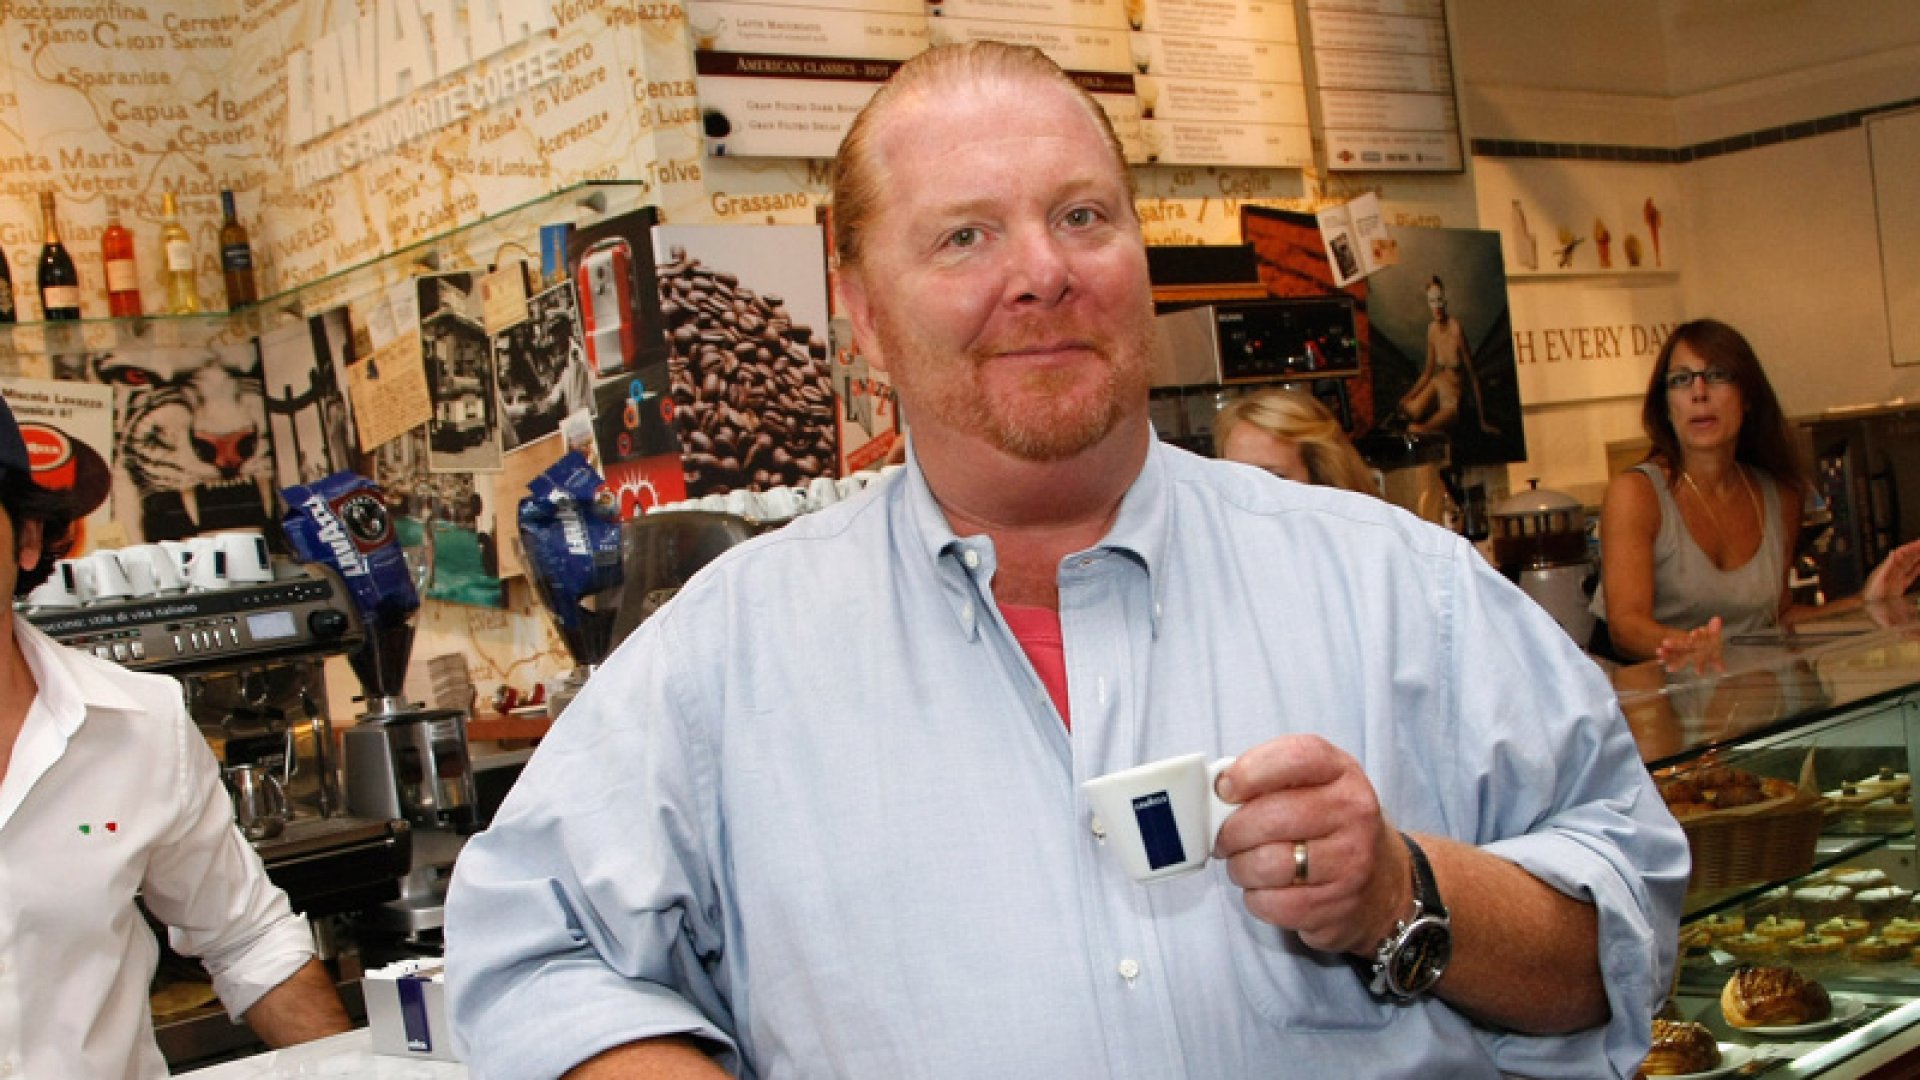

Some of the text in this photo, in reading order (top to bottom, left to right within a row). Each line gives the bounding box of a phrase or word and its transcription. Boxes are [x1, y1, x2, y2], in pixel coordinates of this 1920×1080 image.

[471, 48, 559, 110] COFFEE
[111, 98, 189, 124] Capua
[59, 148, 134, 169] Maria
[712, 191, 808, 216] Grassano
[1543, 325, 1623, 362] EVERY
